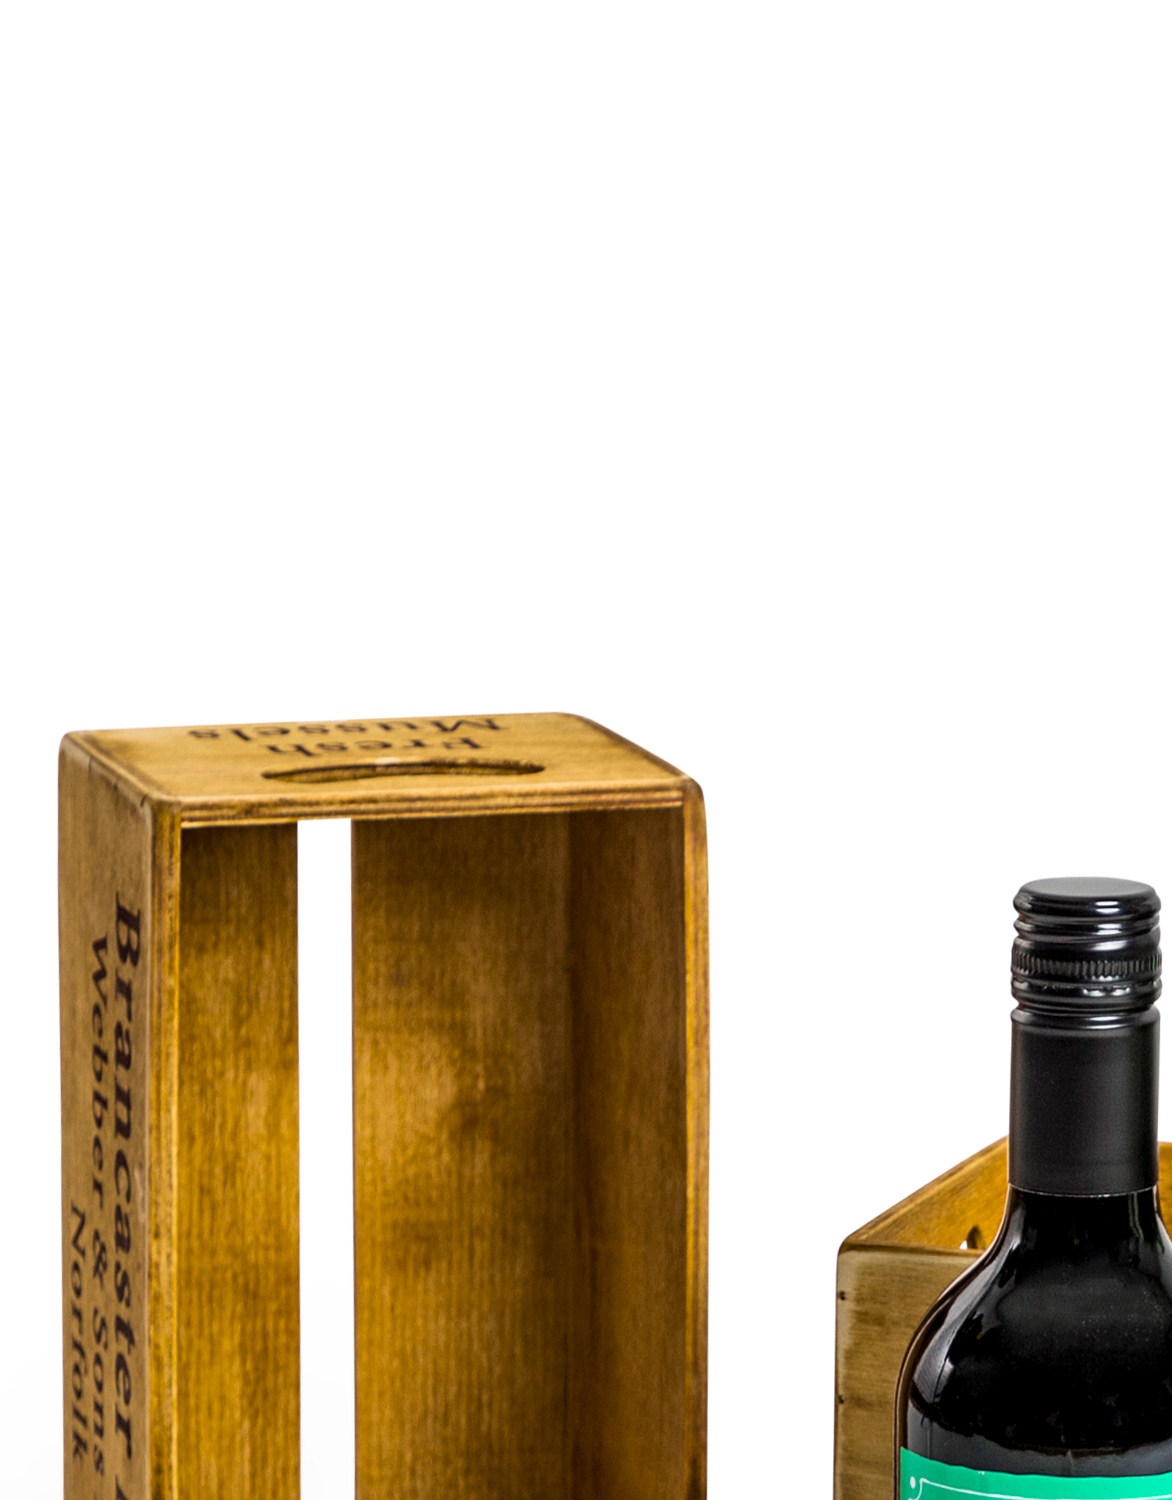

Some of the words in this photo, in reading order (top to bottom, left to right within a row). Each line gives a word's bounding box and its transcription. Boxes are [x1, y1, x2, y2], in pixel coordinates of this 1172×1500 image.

[92, 932, 109, 1210] Webber
[115, 891, 141, 1460] Brancaster
[71, 1199, 88, 1467] Norfolk
[93, 1228, 108, 1291] &
[93, 1307, 109, 1477] Sons
